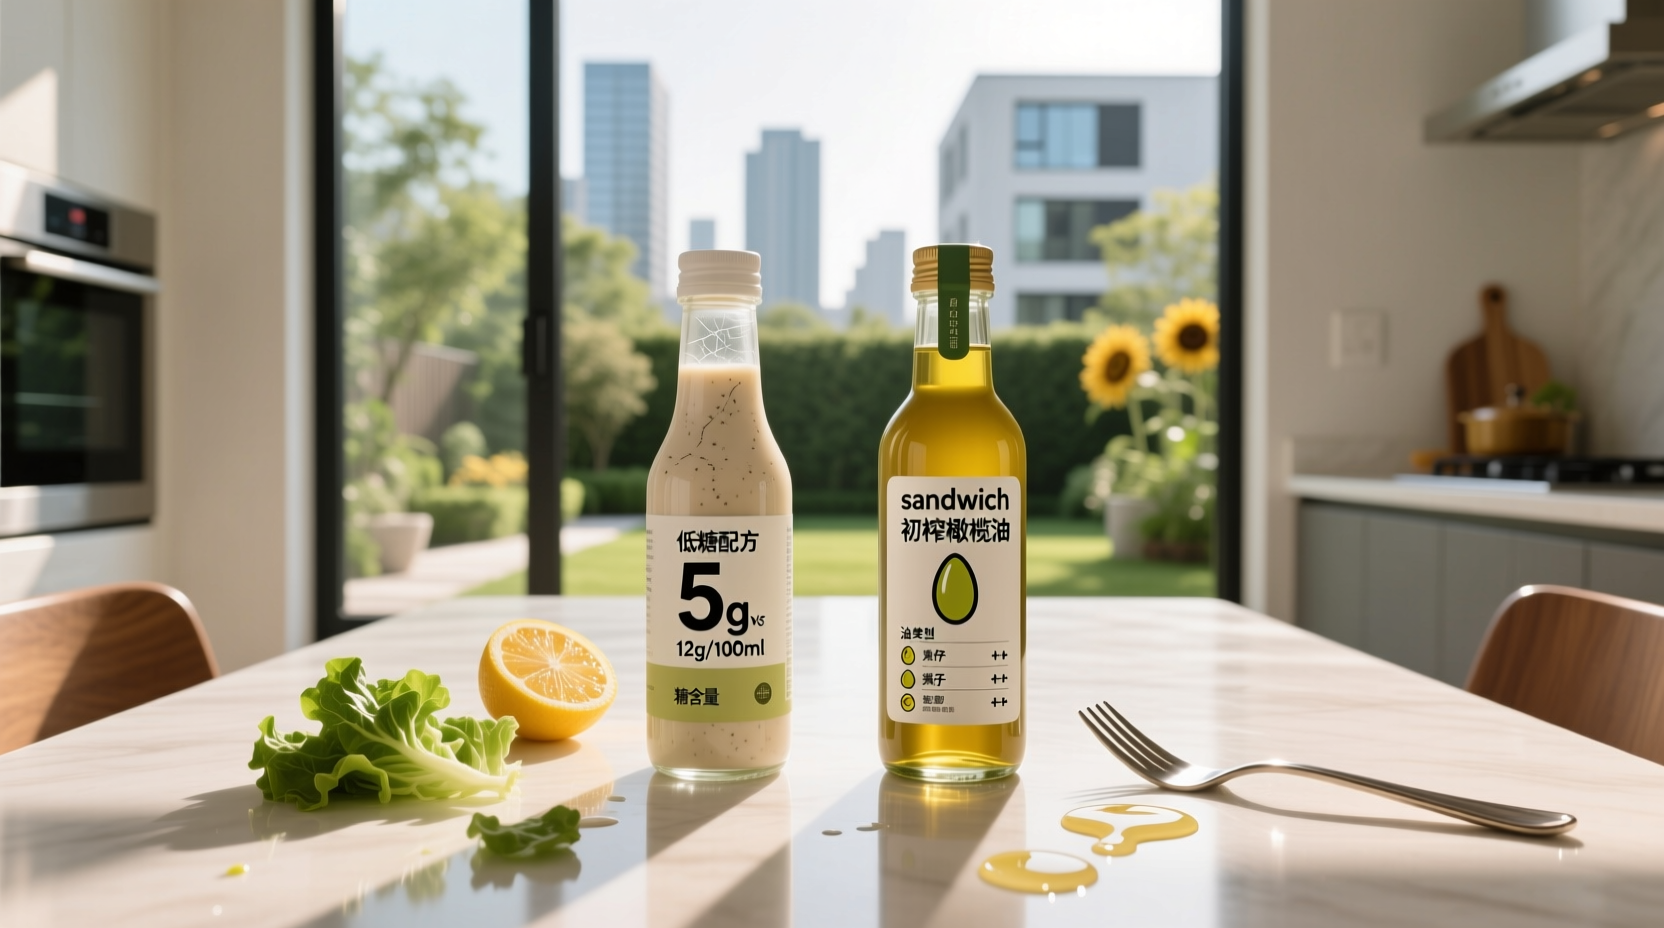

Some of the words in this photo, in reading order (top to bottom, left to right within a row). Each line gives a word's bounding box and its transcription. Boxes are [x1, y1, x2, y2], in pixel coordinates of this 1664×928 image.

[901, 487, 1010, 511] sandwich
[676, 529, 760, 554] 低糖配方
[901, 517, 1010, 543] 初榨橄榄油
[676, 638, 765, 662] 12g/100ml
